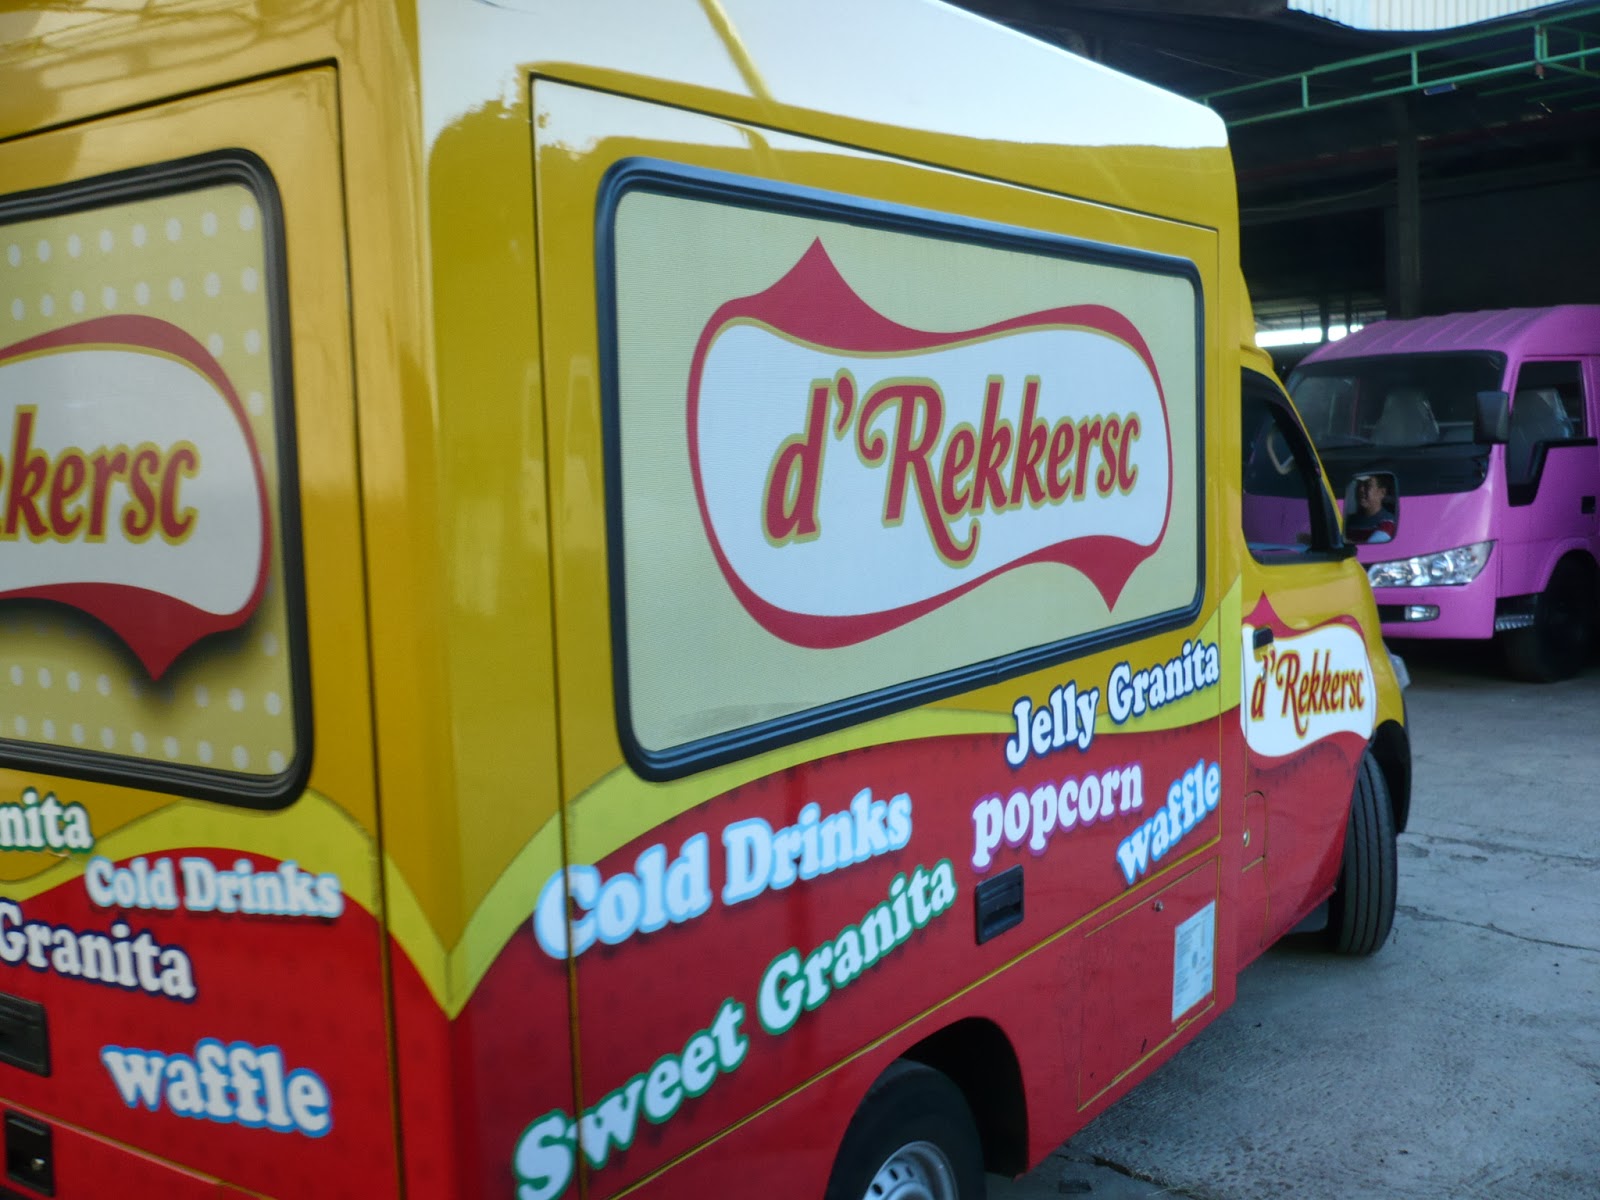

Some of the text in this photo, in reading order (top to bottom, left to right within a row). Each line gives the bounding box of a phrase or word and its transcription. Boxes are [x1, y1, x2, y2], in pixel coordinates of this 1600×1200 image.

[0, 404, 199, 545] kersc
[763, 369, 1140, 567] d'Rekkersc
[1005, 640, 1219, 769] Jelly Granita
[1251, 645, 1365, 738] d'Rekkersc
[0, 787, 94, 852] nita
[534, 787, 912, 959] Cold Drinks
[970, 760, 1144, 873] popcorn
[1116, 758, 1221, 884] waffle
[85, 856, 344, 918] Cold Drinks
[0, 897, 196, 1002] Granita
[101, 1037, 332, 1138] waffle
[513, 997, 749, 1200] Sweet
[757, 858, 957, 1034] Granita
